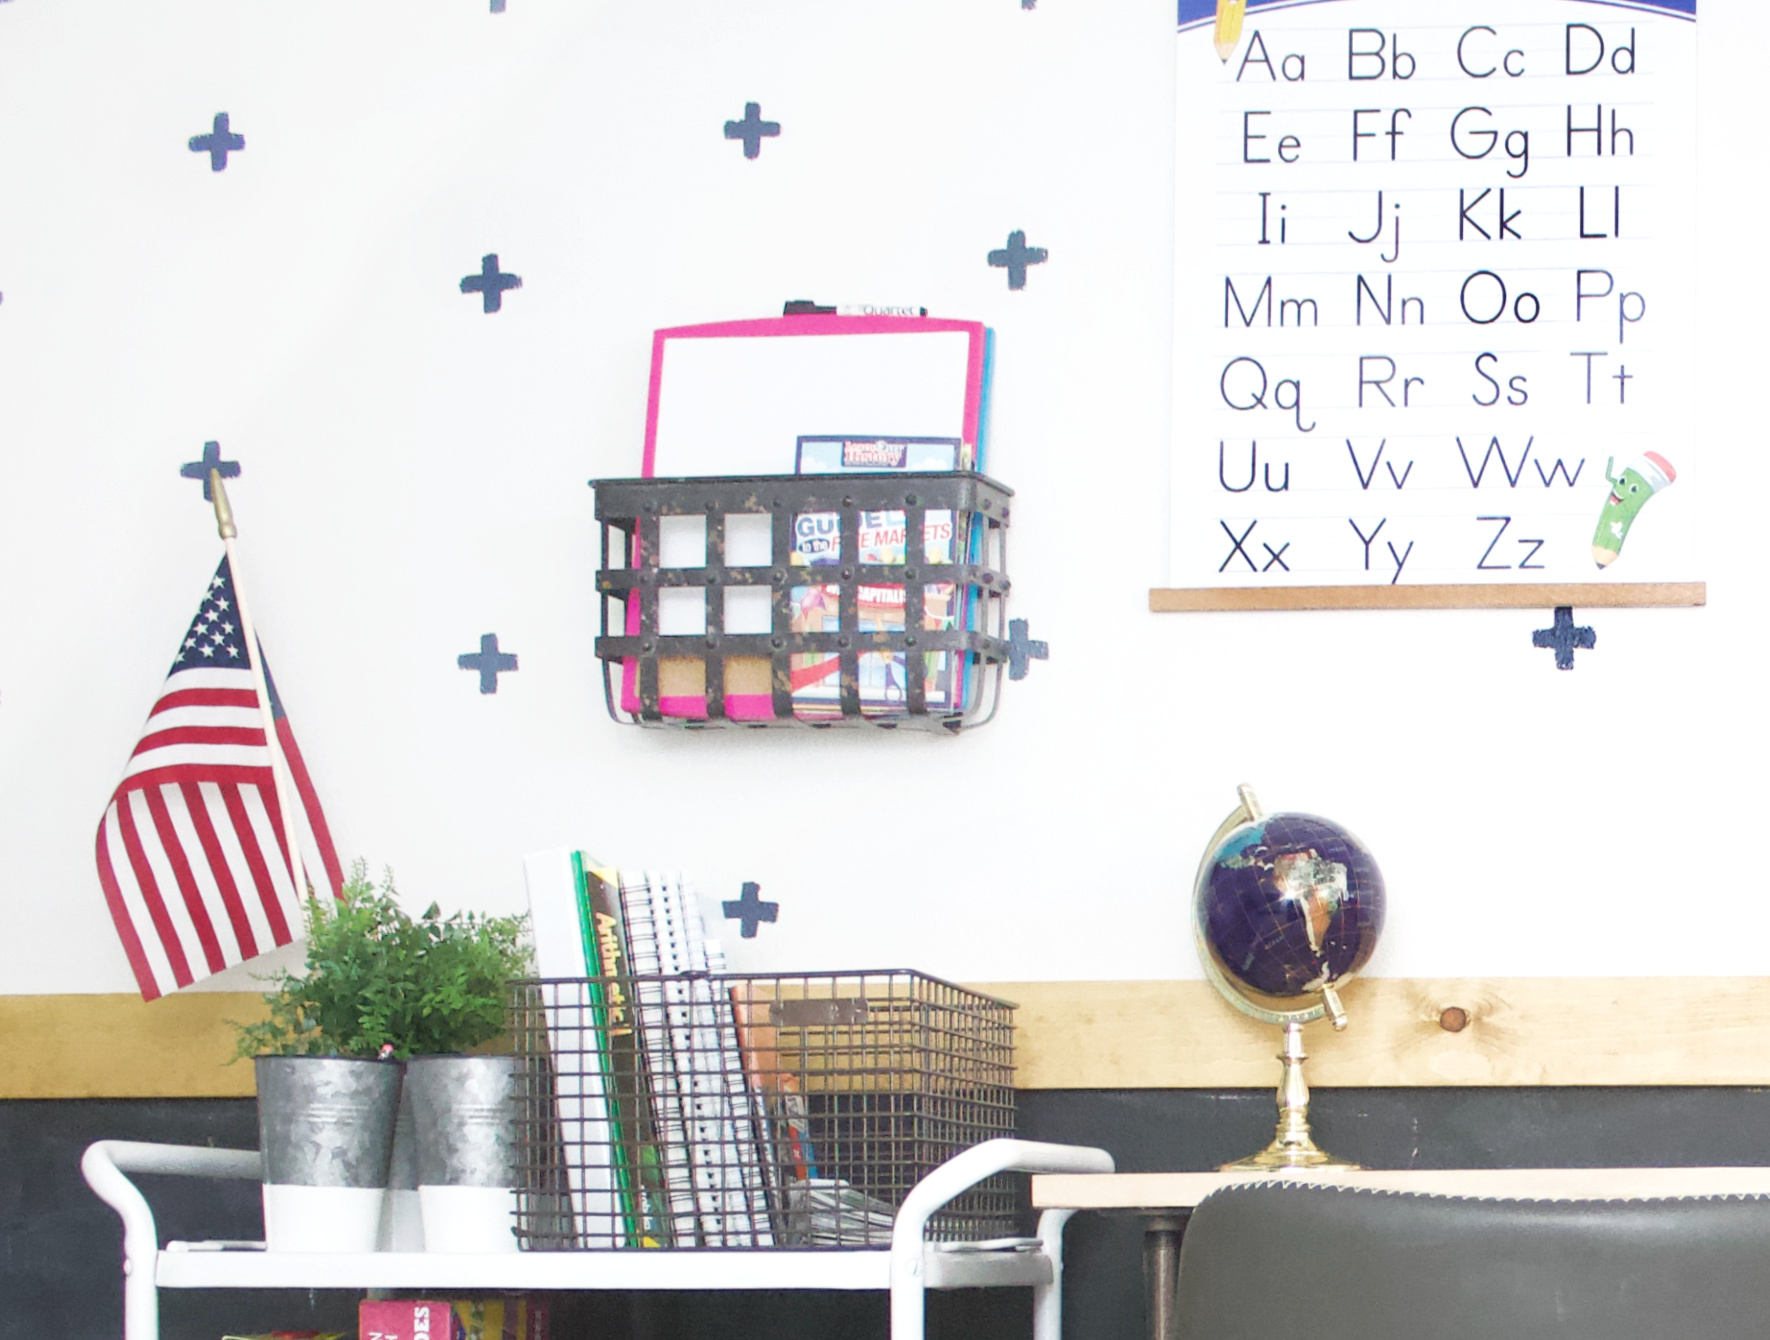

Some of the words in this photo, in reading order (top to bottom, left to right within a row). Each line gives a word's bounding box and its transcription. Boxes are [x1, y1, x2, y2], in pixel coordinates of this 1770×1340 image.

[1237, 30, 1304, 82] Aa
[1349, 28, 1415, 80] Bb
[1457, 26, 1525, 78] Cc
[1566, 24, 1635, 75] Dd
[1244, 110, 1301, 163] Ee
[1353, 109, 1411, 161] Ff
[1451, 106, 1529, 179] Gg
[1567, 104, 1634, 156] Hh
[1258, 192, 1286, 244] Ii
[1348, 191, 1401, 262] Jj
[1460, 188, 1521, 240] Kk
[1580, 186, 1618, 238] Ll
[1225, 276, 1317, 326] Mm
[1357, 274, 1424, 325] Nn
[1460, 270, 1540, 323] Oo
[1577, 269, 1646, 343] Pp
[1220, 357, 1316, 432] Qq
[1359, 356, 1425, 407] Rr
[1472, 353, 1528, 406] Ss
[1570, 352, 1633, 404] Tt
[844, 451, 901, 466] History
[1219, 440, 1289, 492] Uu
[1346, 438, 1413, 489] Vv
[1456, 435, 1585, 487] Ww
[797, 510, 882, 538] GUE
[1219, 519, 1290, 572] Xx
[1349, 518, 1413, 584] Yy
[1476, 516, 1545, 569] Zz
